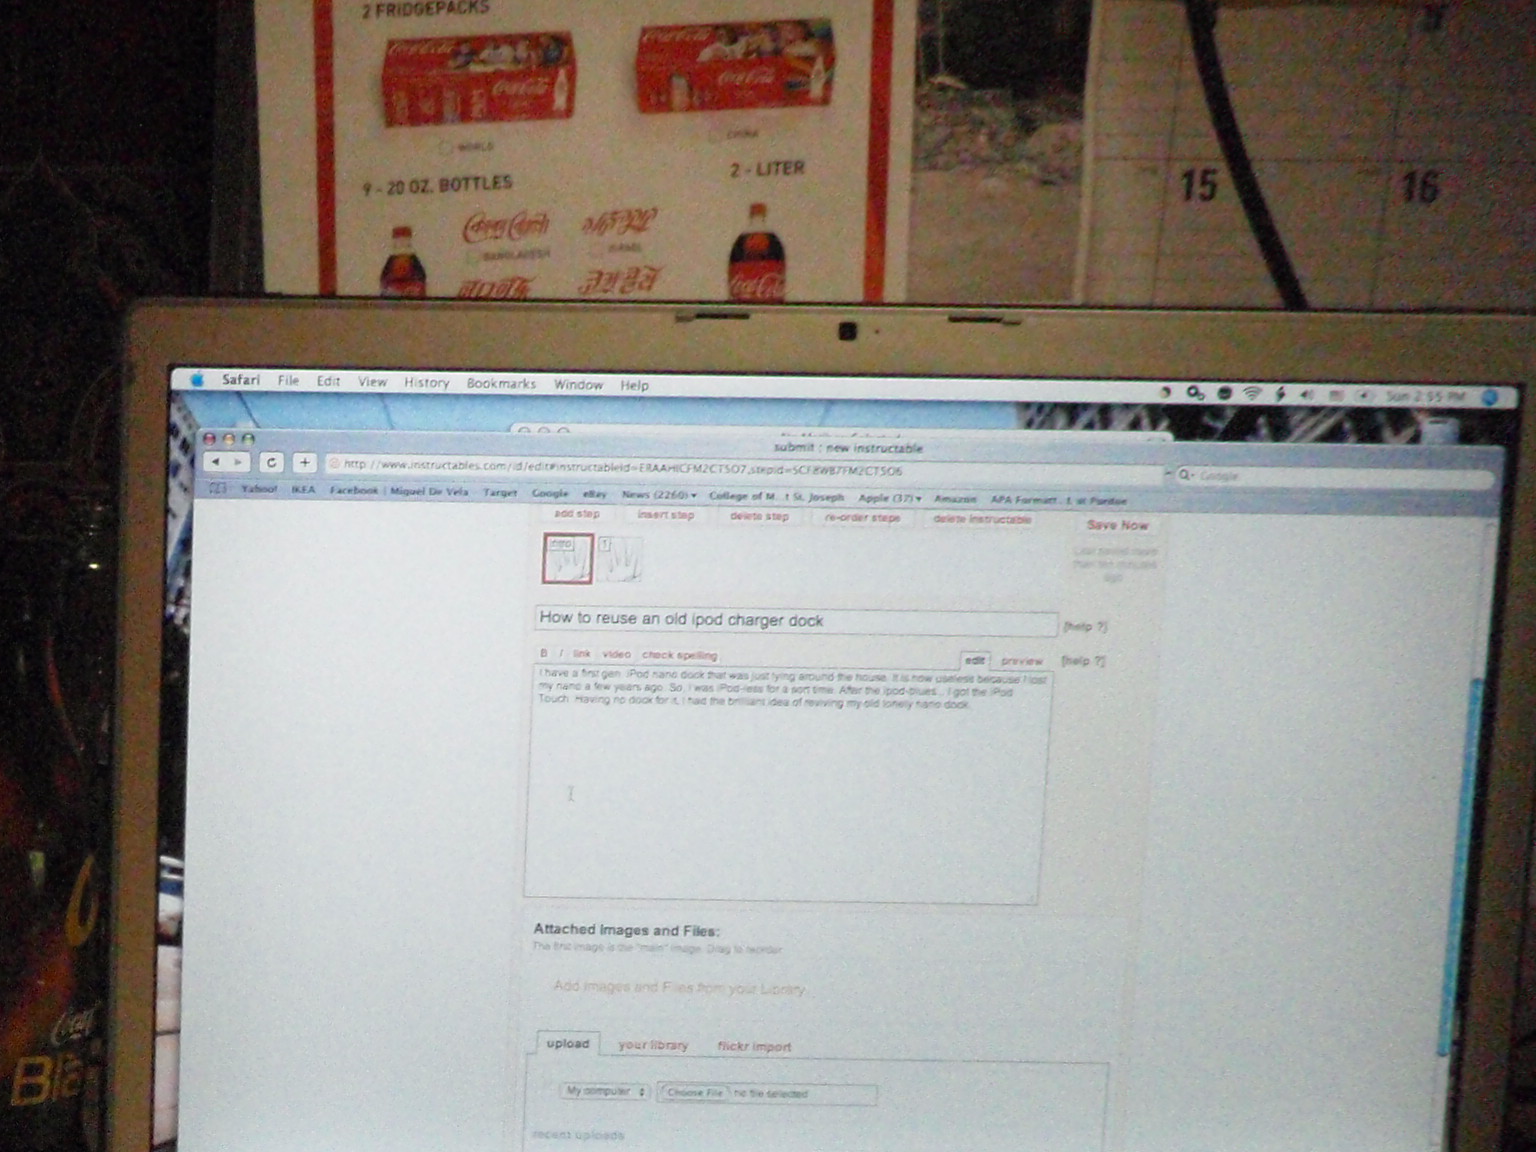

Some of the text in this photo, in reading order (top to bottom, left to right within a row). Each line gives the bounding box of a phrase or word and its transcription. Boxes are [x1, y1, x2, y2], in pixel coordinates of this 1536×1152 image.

[362, 0, 490, 19] 2 FRIDGEPACKS
[731, 163, 740, 178] 2
[756, 161, 805, 176] LITER
[363, 183, 371, 196] 9
[388, 180, 405, 195] 20
[410, 180, 433, 194] OZ.
[439, 175, 512, 193] BOTTLES
[1182, 168, 1218, 203] 15
[1402, 171, 1439, 205] 16
[223, 374, 649, 392] Safari File Edit View History Bookmarks Window Help
[774, 443, 814, 452] submit
[854, 445, 923, 454] instructable
[241, 485, 278, 493] Yahoo!
[292, 486, 315, 494] IKEA
[330, 487, 378, 495] Facebook
[390, 487, 425, 496] Miguel
[429, 488, 442, 496] De
[484, 488, 517, 498] Target
[532, 489, 568, 498] Google
[583, 490, 606, 499] eBay
[622, 491, 650, 499] News
[709, 492, 747, 501] College
[752, 492, 763, 500] of
[808, 494, 844, 502] Joseph
[859, 495, 889, 503] Apple
[934, 494, 977, 504] Amazon
[991, 495, 1012, 504] APA
[1090, 497, 1127, 505] Purdue
[555, 509, 600, 519] add step
[638, 510, 695, 521] insert step
[730, 511, 789, 522] delete step
[825, 513, 901, 524] re-order steps
[933, 514, 1032, 525] delete instructable
[1087, 519, 1149, 531] Save Now
[540, 611, 823, 630] How to reuse an old ipod charger dock
[541, 649, 718, 662] B link video check spelling
[965, 656, 1043, 667] edit preview
[534, 923, 720, 937] Attached Images and Files:
[555, 980, 579, 991] Add
[584, 981, 629, 995] Images
[634, 982, 658, 993] and
[664, 982, 694, 994] Files
[728, 985, 756, 996] your
[547, 1039, 589, 1050] upload
[618, 1040, 689, 1052] your library
[718, 1041, 792, 1053] flickr import
[568, 1086, 630, 1097] My computer
[668, 1088, 723, 1098] Choose File
[767, 1090, 808, 1099] selected
[575, 1130, 625, 1141] uploads
